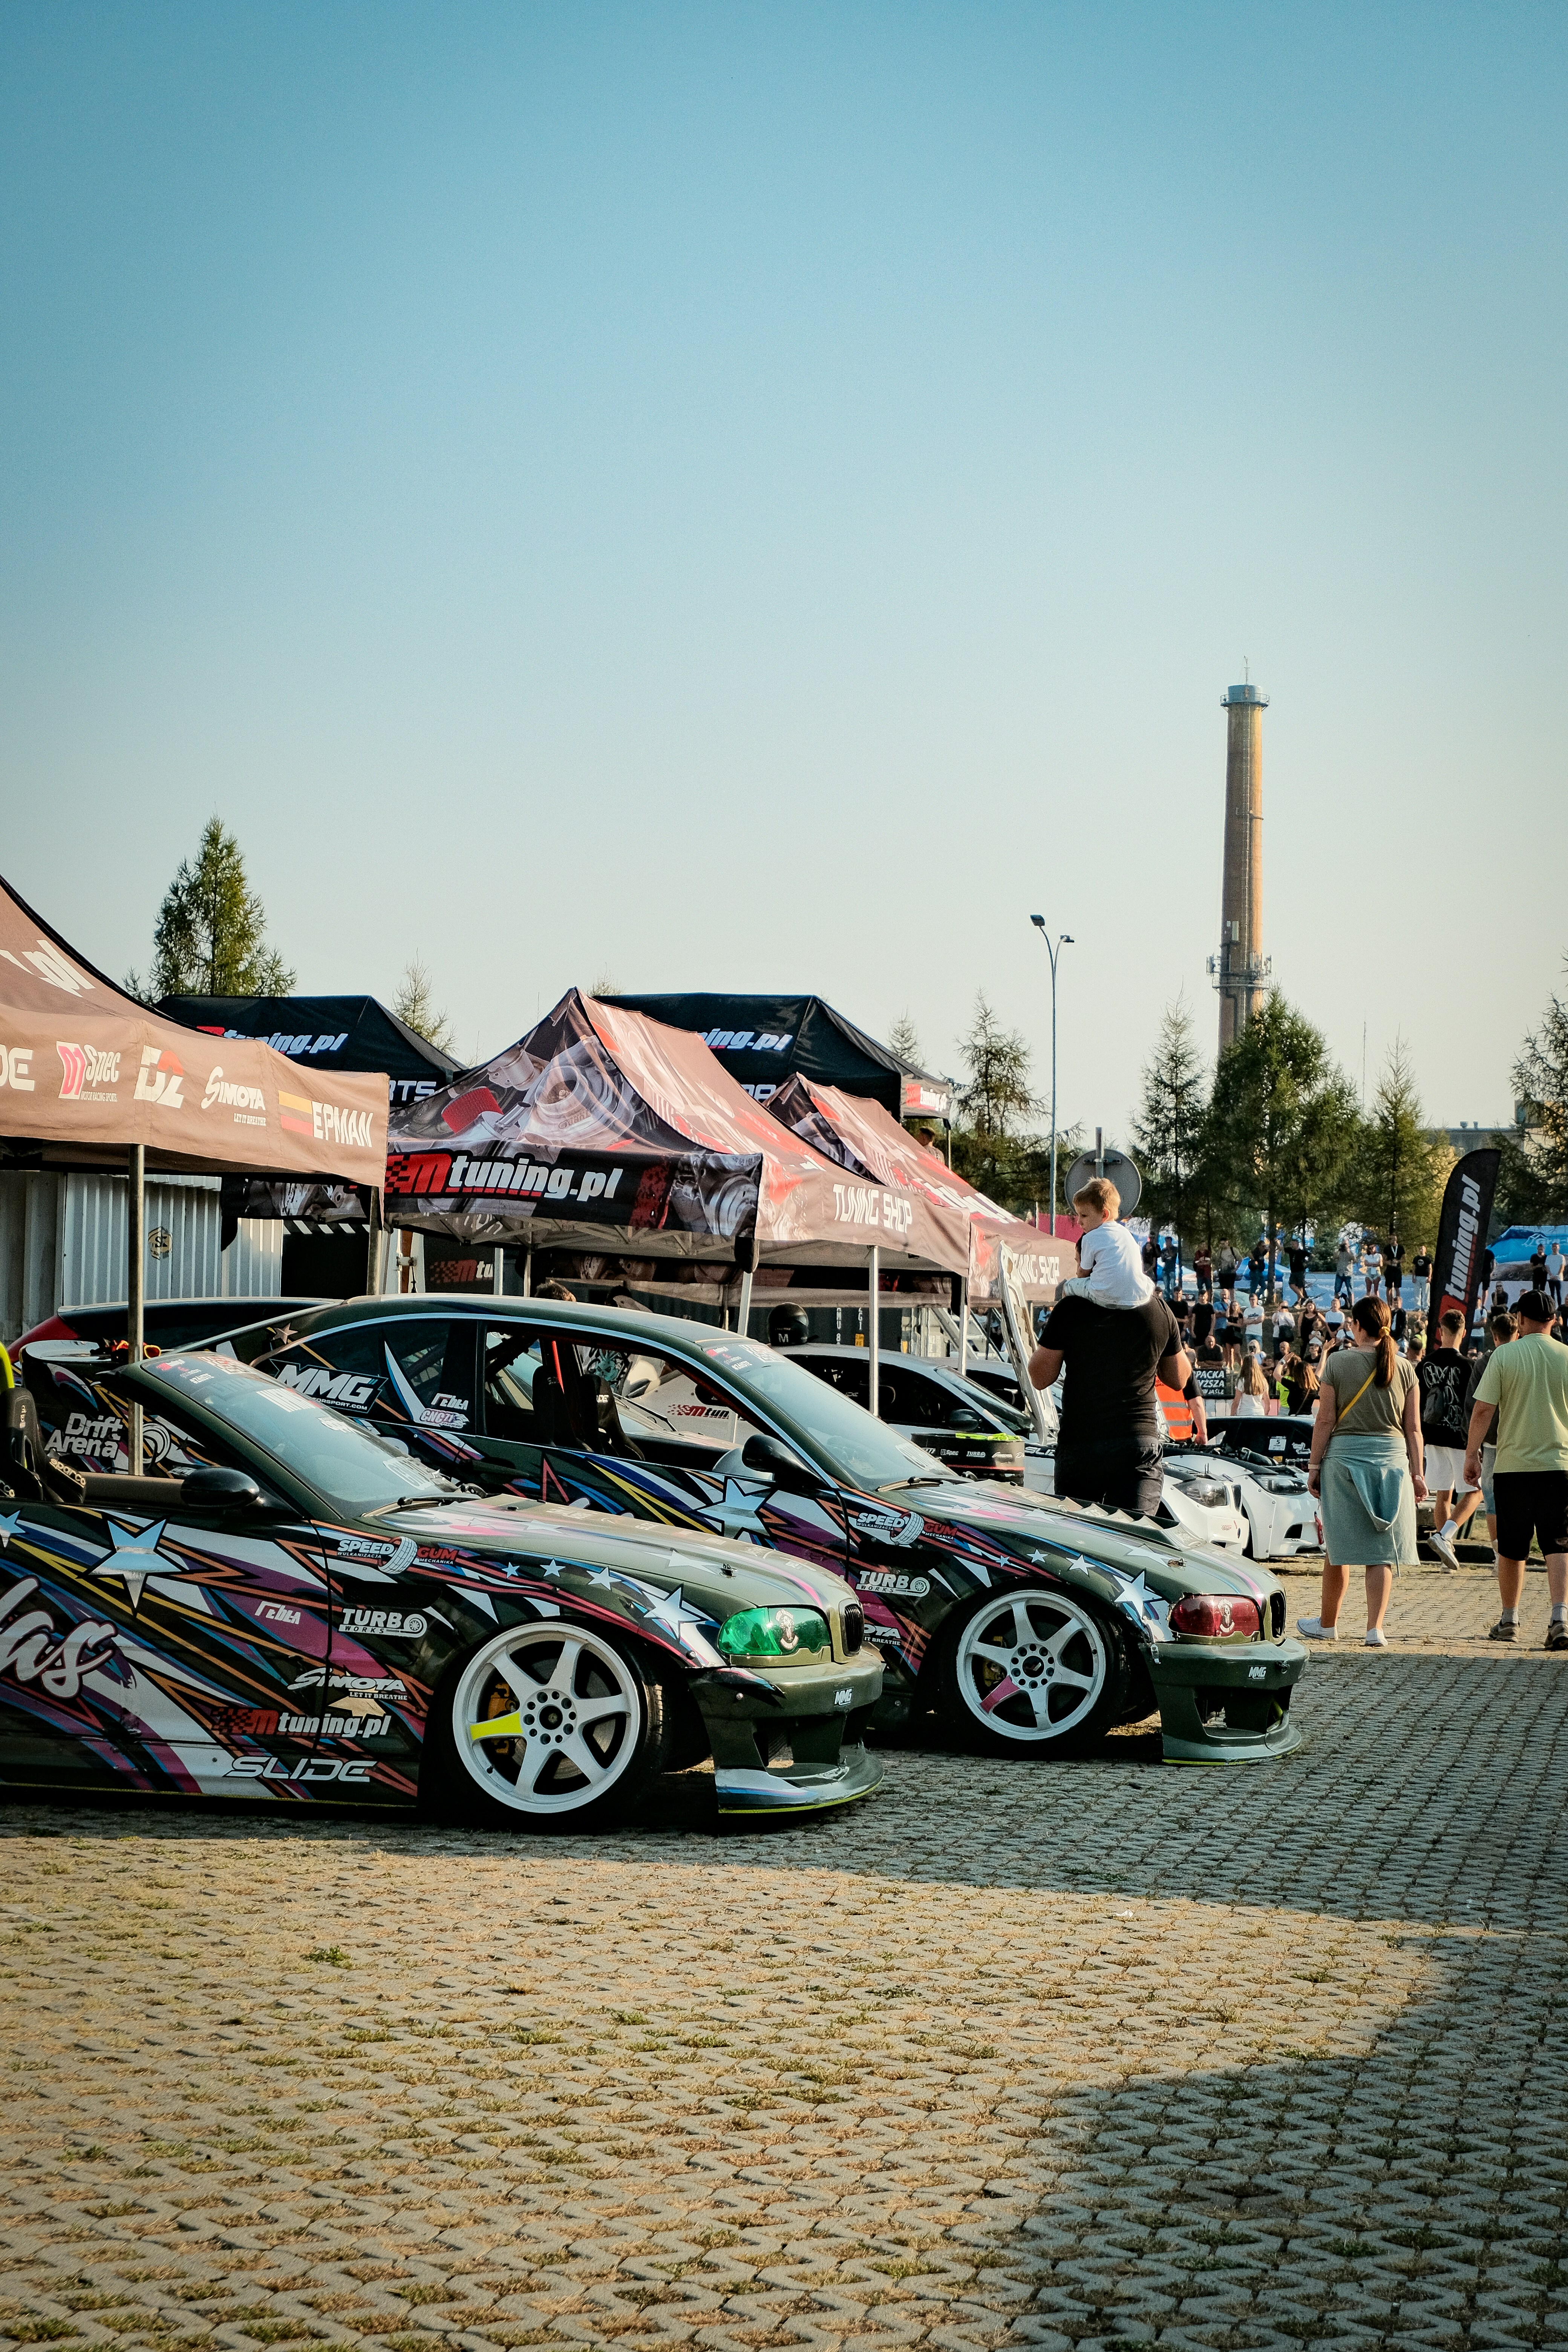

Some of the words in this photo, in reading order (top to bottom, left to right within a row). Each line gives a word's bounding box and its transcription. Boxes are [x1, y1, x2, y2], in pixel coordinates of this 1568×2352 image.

[84, 1044, 121, 1087] Spec
[93, 1092, 106, 1101] RACING
[234, 1113, 242, 1122] LET
[242, 1114, 247, 1124] IT
[247, 1115, 266, 1126] BREATHE
[833, 1184, 879, 1225] TUNING
[883, 1192, 913, 1233] SHOP
[1039, 1256, 1060, 1285] SHOP
[276, 1364, 377, 1404] MMG
[65, 1412, 124, 1440] Drift
[44, 1430, 119, 1458] Arena
[49, 1458, 87, 1487] sparco
[857, 1522, 894, 1531] WULKANIZACJA
[858, 1513, 905, 1528] SPEED
[923, 1522, 959, 1536] GUM
[339, 1539, 396, 1555] SPEED
[417, 1547, 459, 1560] GUM
[861, 1585, 894, 1593] WORKS
[345, 1625, 385, 1634] WORKS
[1248, 1666, 1266, 1677] MMG
[287, 1668, 406, 1692] SIMOTA
[835, 1689, 852, 1704] MMG
[227, 1756, 377, 1782] SLIDE
